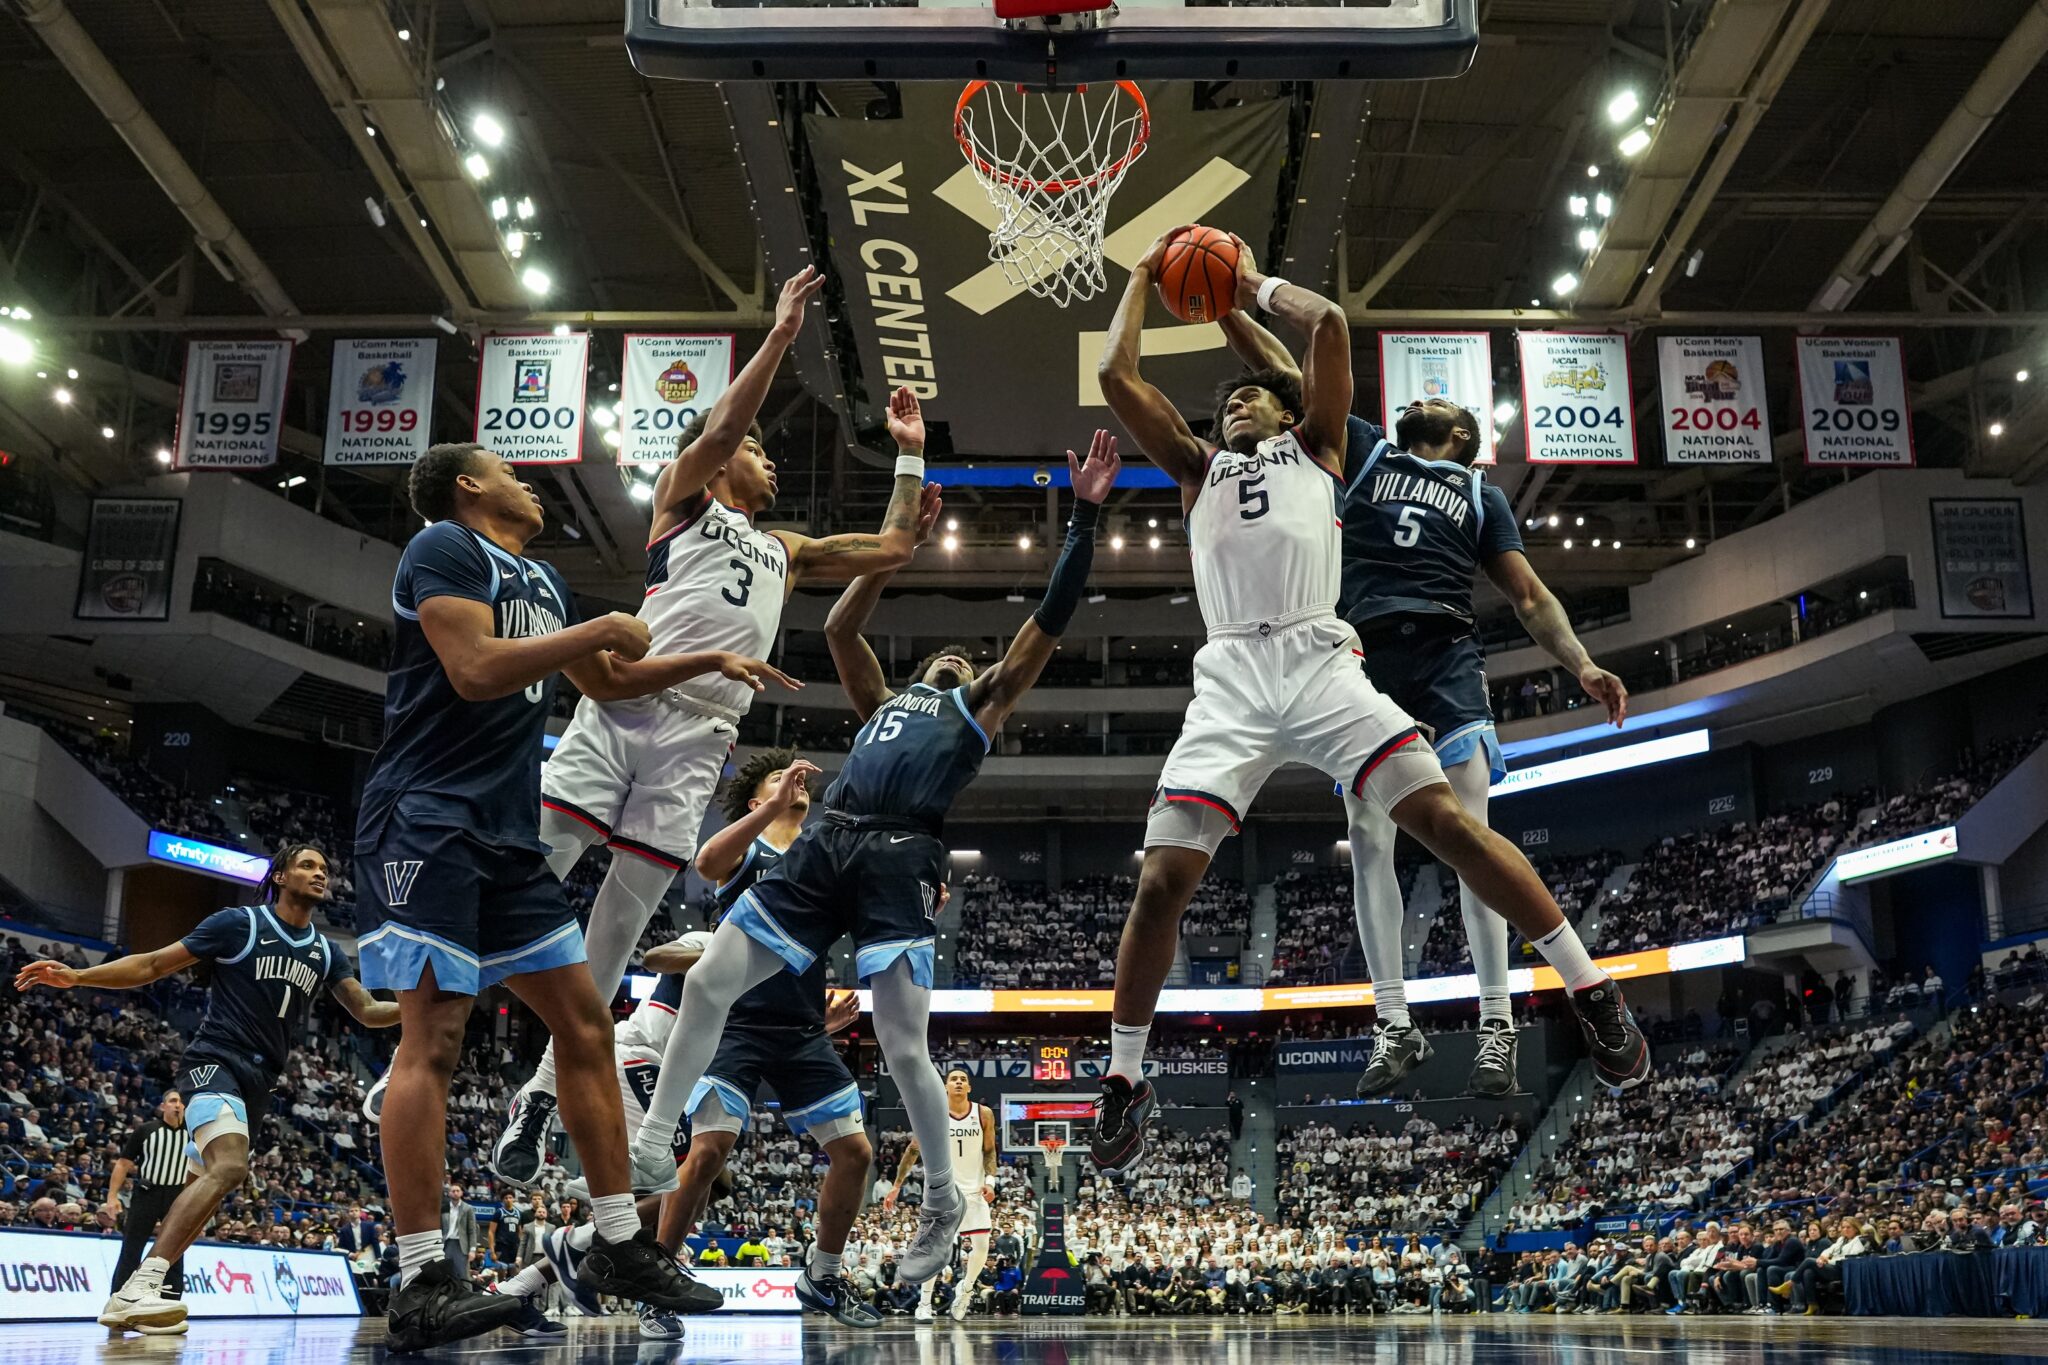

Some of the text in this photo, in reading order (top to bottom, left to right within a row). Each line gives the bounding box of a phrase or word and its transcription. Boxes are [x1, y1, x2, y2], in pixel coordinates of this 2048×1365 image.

[841, 159, 939, 400] XL CENTER
[352, 340, 387, 349] UConn
[493, 338, 527, 346] UConn
[637, 338, 722, 346] UConn Women's
[1391, 336, 1477, 344] UConn Women's
[1531, 336, 1616, 344] UConn Women's
[1675, 338, 1743, 346] UConn Men's
[1805, 339, 1840, 347] UConn
[358, 351, 412, 360] Basketball
[508, 349, 562, 357] Basketball
[652, 349, 706, 357] Basketball
[1408, 347, 1462, 355] Basketball
[1548, 347, 1601, 355] Basketball
[1683, 349, 1737, 357] Basketball
[1822, 350, 1876, 358] Basketball
[656, 379, 691, 391] Final
[340, 409, 418, 433] 1999
[484, 407, 575, 430] 2000
[631, 408, 698, 430] 200
[1534, 406, 1624, 428] 2004
[1671, 407, 1761, 431] 2004
[1812, 408, 1900, 431] 2009
[195, 412, 271, 435] 1995
[342, 437, 412, 447] NATIONAL
[493, 435, 563, 445] NATIONAL
[1545, 434, 1616, 443] NATIONAL
[1683, 435, 1753, 445] NATIONAL
[1823, 437, 1893, 446] NATIONAL
[195, 441, 266, 450] NATIONAL
[335, 451, 417, 462] CHAMPIONS
[490, 449, 568, 459] HAMPIONS
[1540, 448, 1623, 457] CHAMPIONS
[1678, 450, 1761, 460] CHAMPIONS
[1818, 451, 1901, 460] CHAMPIONS
[188, 454, 270, 464] CHAMPIONS
[1211, 449, 1300, 487] UCONN
[1239, 474, 1270, 520] 5
[1372, 473, 1468, 528] VILLANOVA
[1393, 505, 1427, 547] 5
[701, 521, 783, 579] UCONN
[721, 559, 753, 607] 3
[865, 711, 909, 745] 15
[164, 732, 190, 746] 220
[1500, 769, 1542, 785] ARCUS
[1809, 766, 1832, 783] 229
[1524, 831, 1547, 844] 228
[167, 842, 210, 864] xfinity
[278, 985, 291, 1018] 1
[1041, 1047, 1068, 1058] 10:04
[1278, 1050, 1372, 1065] UCONN NAT
[1041, 1060, 1065, 1080] 30
[1160, 1062, 1228, 1074] HUSKIES
[1394, 1104, 1413, 1112] 123
[949, 1129, 980, 1137] CONN
[957, 1140, 962, 1157] 1
[0, 1263, 91, 1292] UCONN
[183, 1267, 216, 1294] ank
[298, 1276, 345, 1296] UCONN
[1022, 1294, 1086, 1306] TRAVELERS
